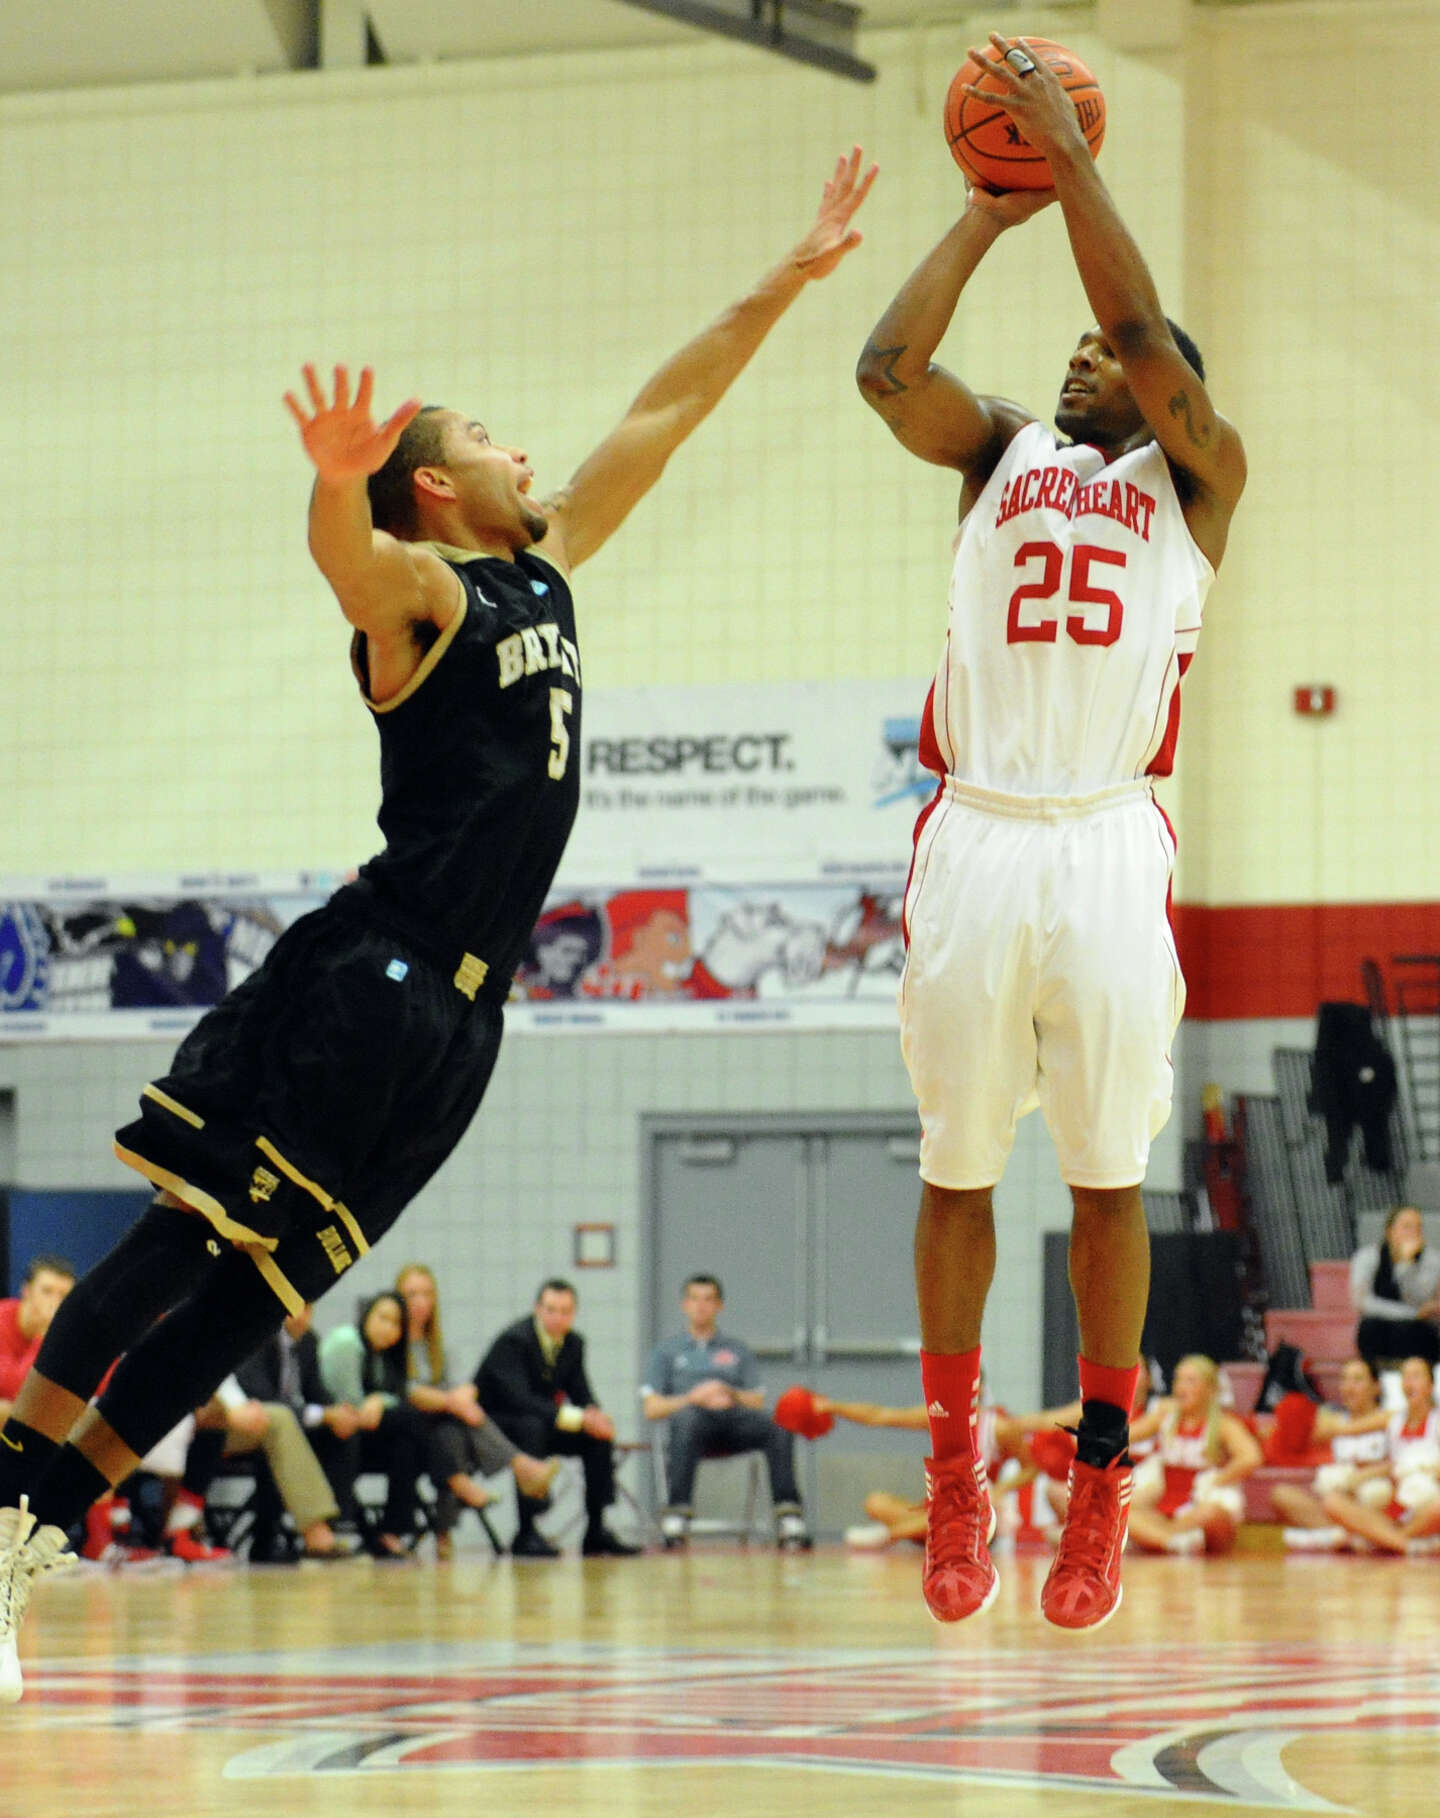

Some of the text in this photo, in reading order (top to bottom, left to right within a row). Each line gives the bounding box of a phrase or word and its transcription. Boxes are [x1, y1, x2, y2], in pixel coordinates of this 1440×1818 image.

[1075, 479, 1156, 543] HEART
[1007, 541, 1127, 648] 25
[548, 687, 573, 781] 5
[587, 734, 795, 775] RESPECT.
[619, 790, 648, 810] the
[658, 793, 711, 809] name
[720, 788, 742, 808] of
[747, 787, 776, 808] the
